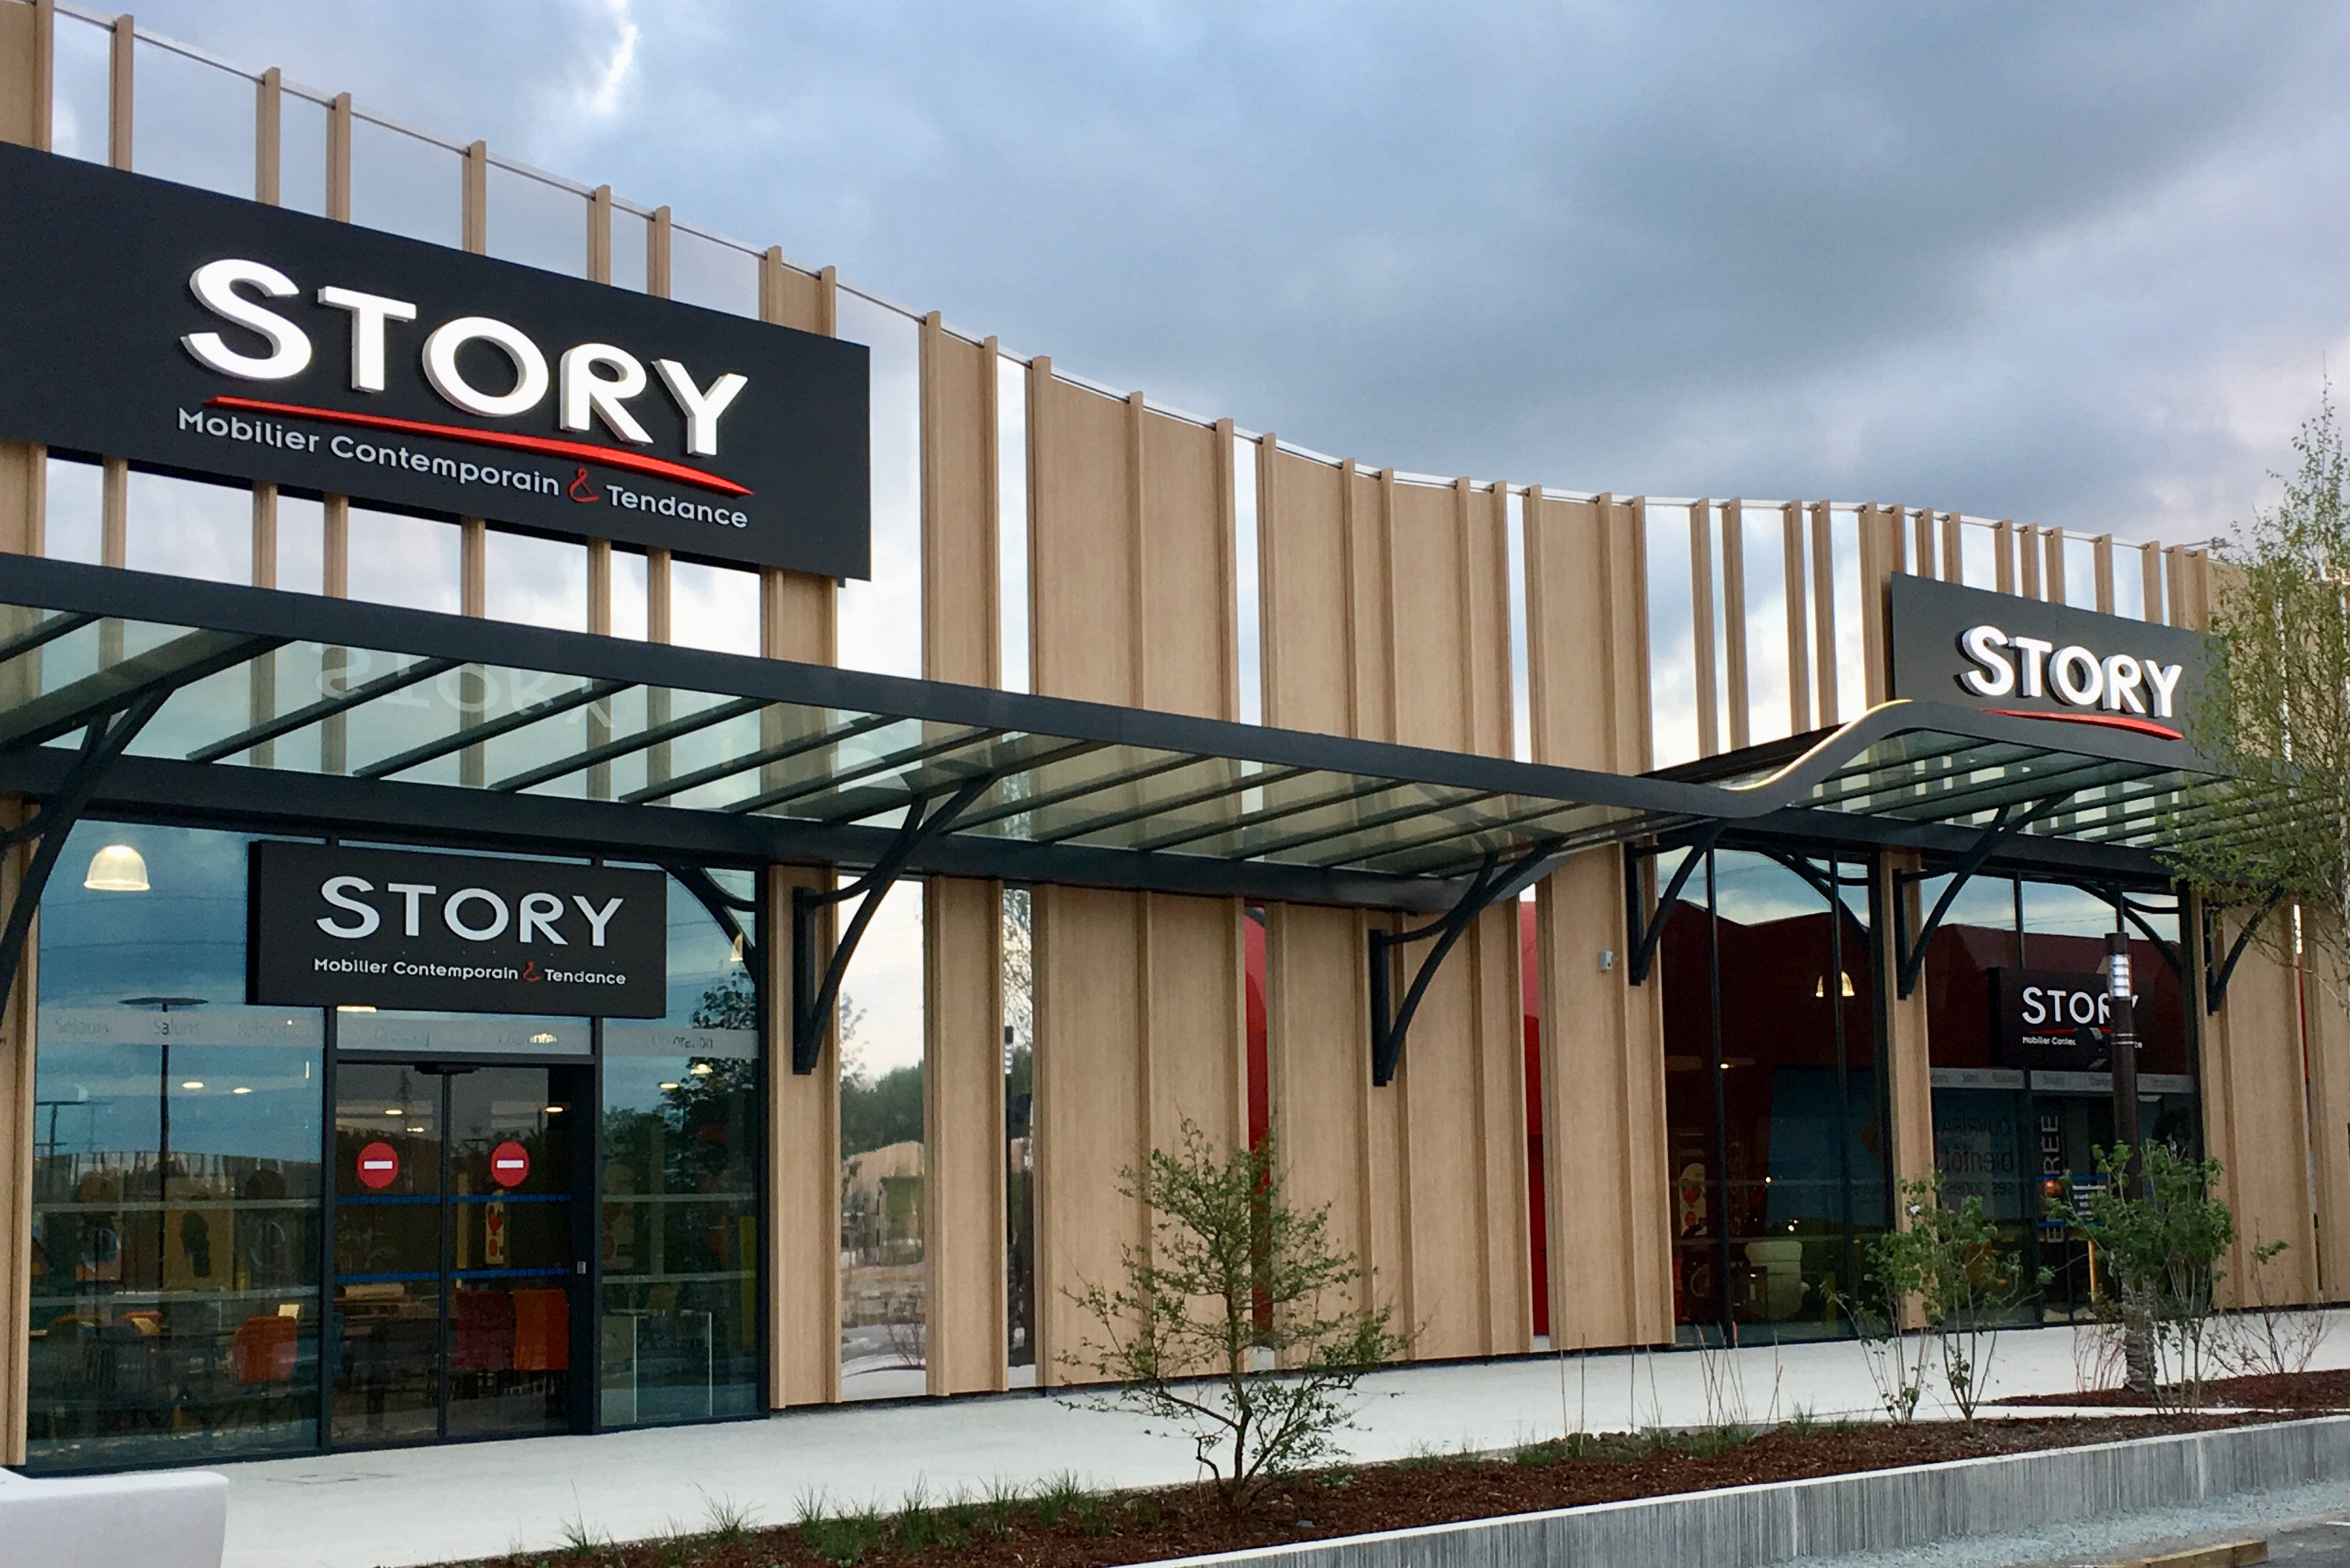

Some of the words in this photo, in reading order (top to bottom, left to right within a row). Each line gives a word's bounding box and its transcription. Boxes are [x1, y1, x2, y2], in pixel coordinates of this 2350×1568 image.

[180, 258, 749, 457] STORY
[178, 407, 319, 452] Mobilier
[330, 435, 560, 496] Contemporain
[567, 466, 600, 504] &
[606, 484, 749, 529] Tendance
[1958, 624, 2183, 718] STORY
[316, 875, 624, 947] STORY
[314, 958, 388, 975] Mobilier
[393, 960, 519, 980] Contemporain
[522, 961, 542, 983] &
[544, 968, 626, 985] Tendance
[2022, 986, 2139, 1025] STOR
